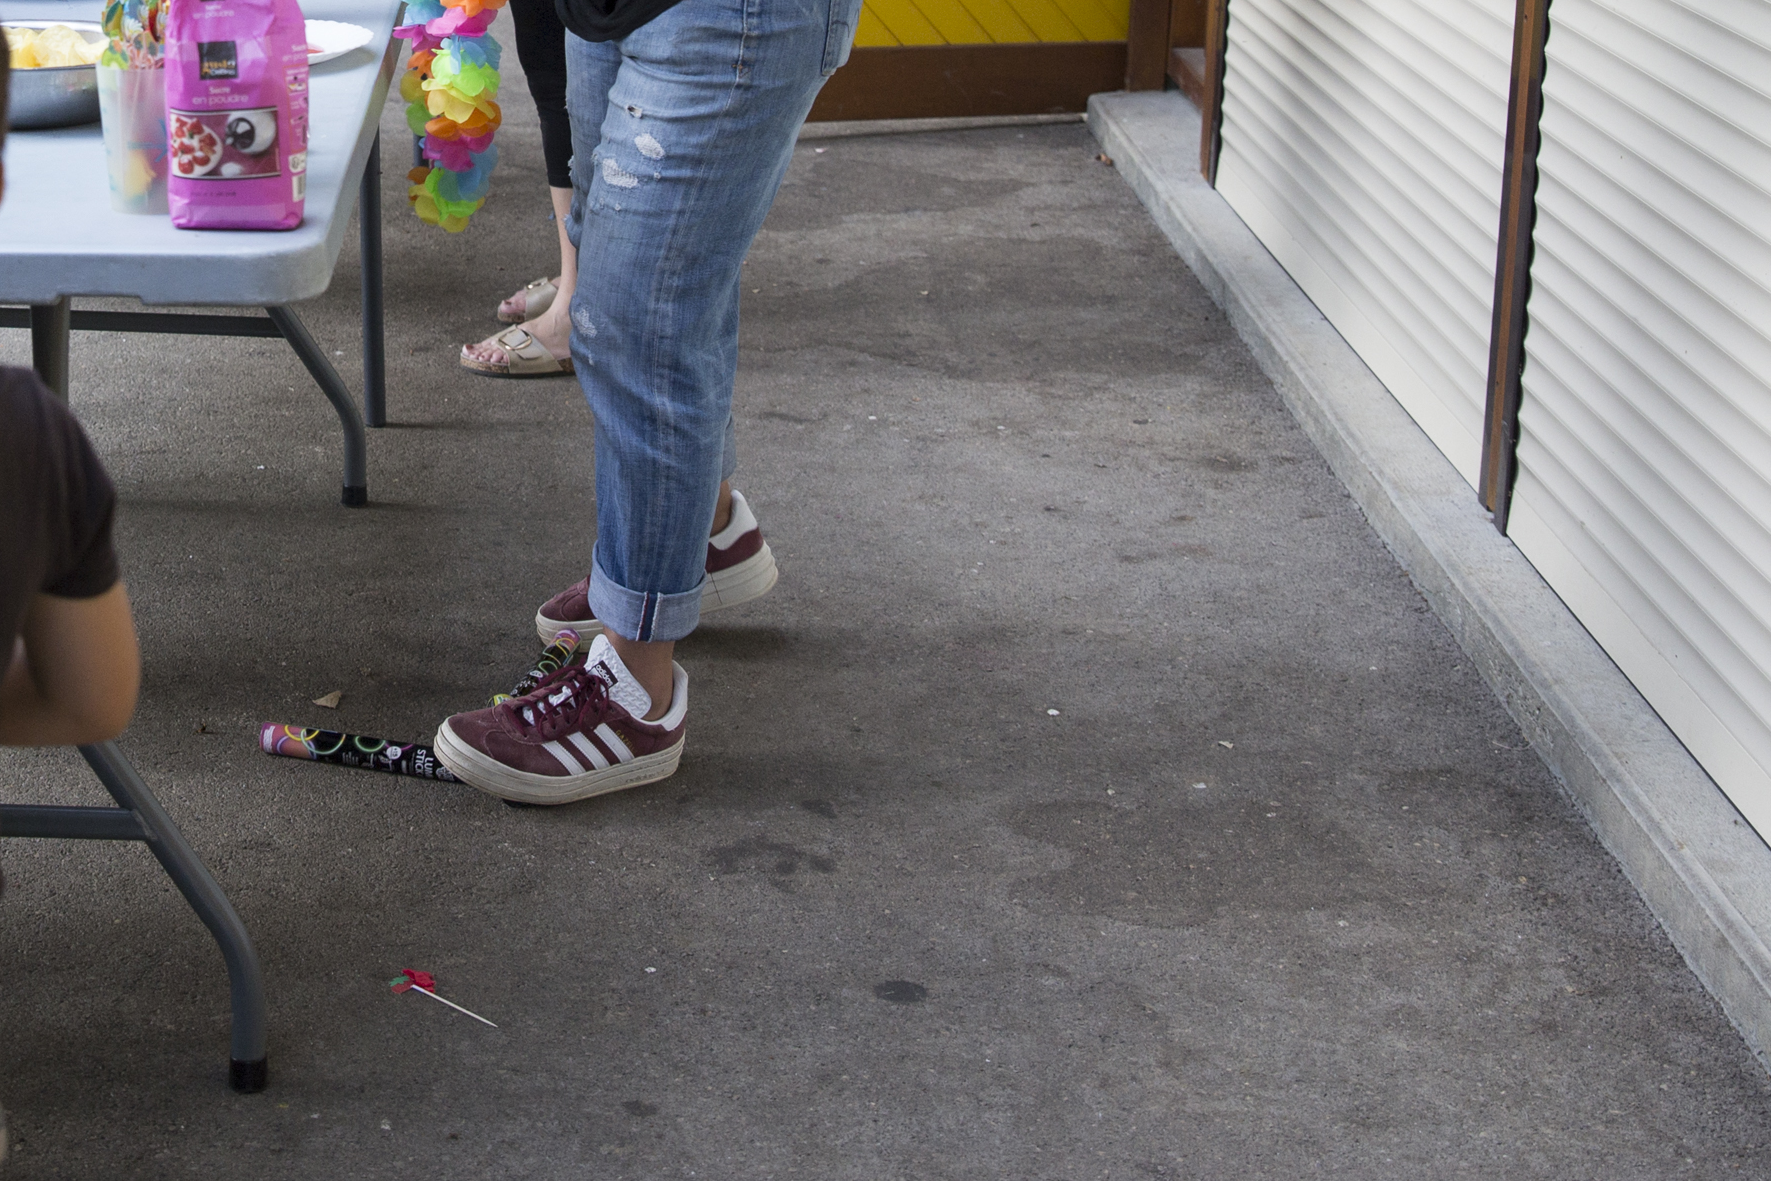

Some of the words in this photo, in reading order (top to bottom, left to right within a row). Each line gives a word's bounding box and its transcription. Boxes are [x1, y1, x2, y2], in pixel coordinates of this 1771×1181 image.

[192, 96, 207, 105] en
[208, 94, 249, 106] poudre
[595, 663, 614, 687] adidas
